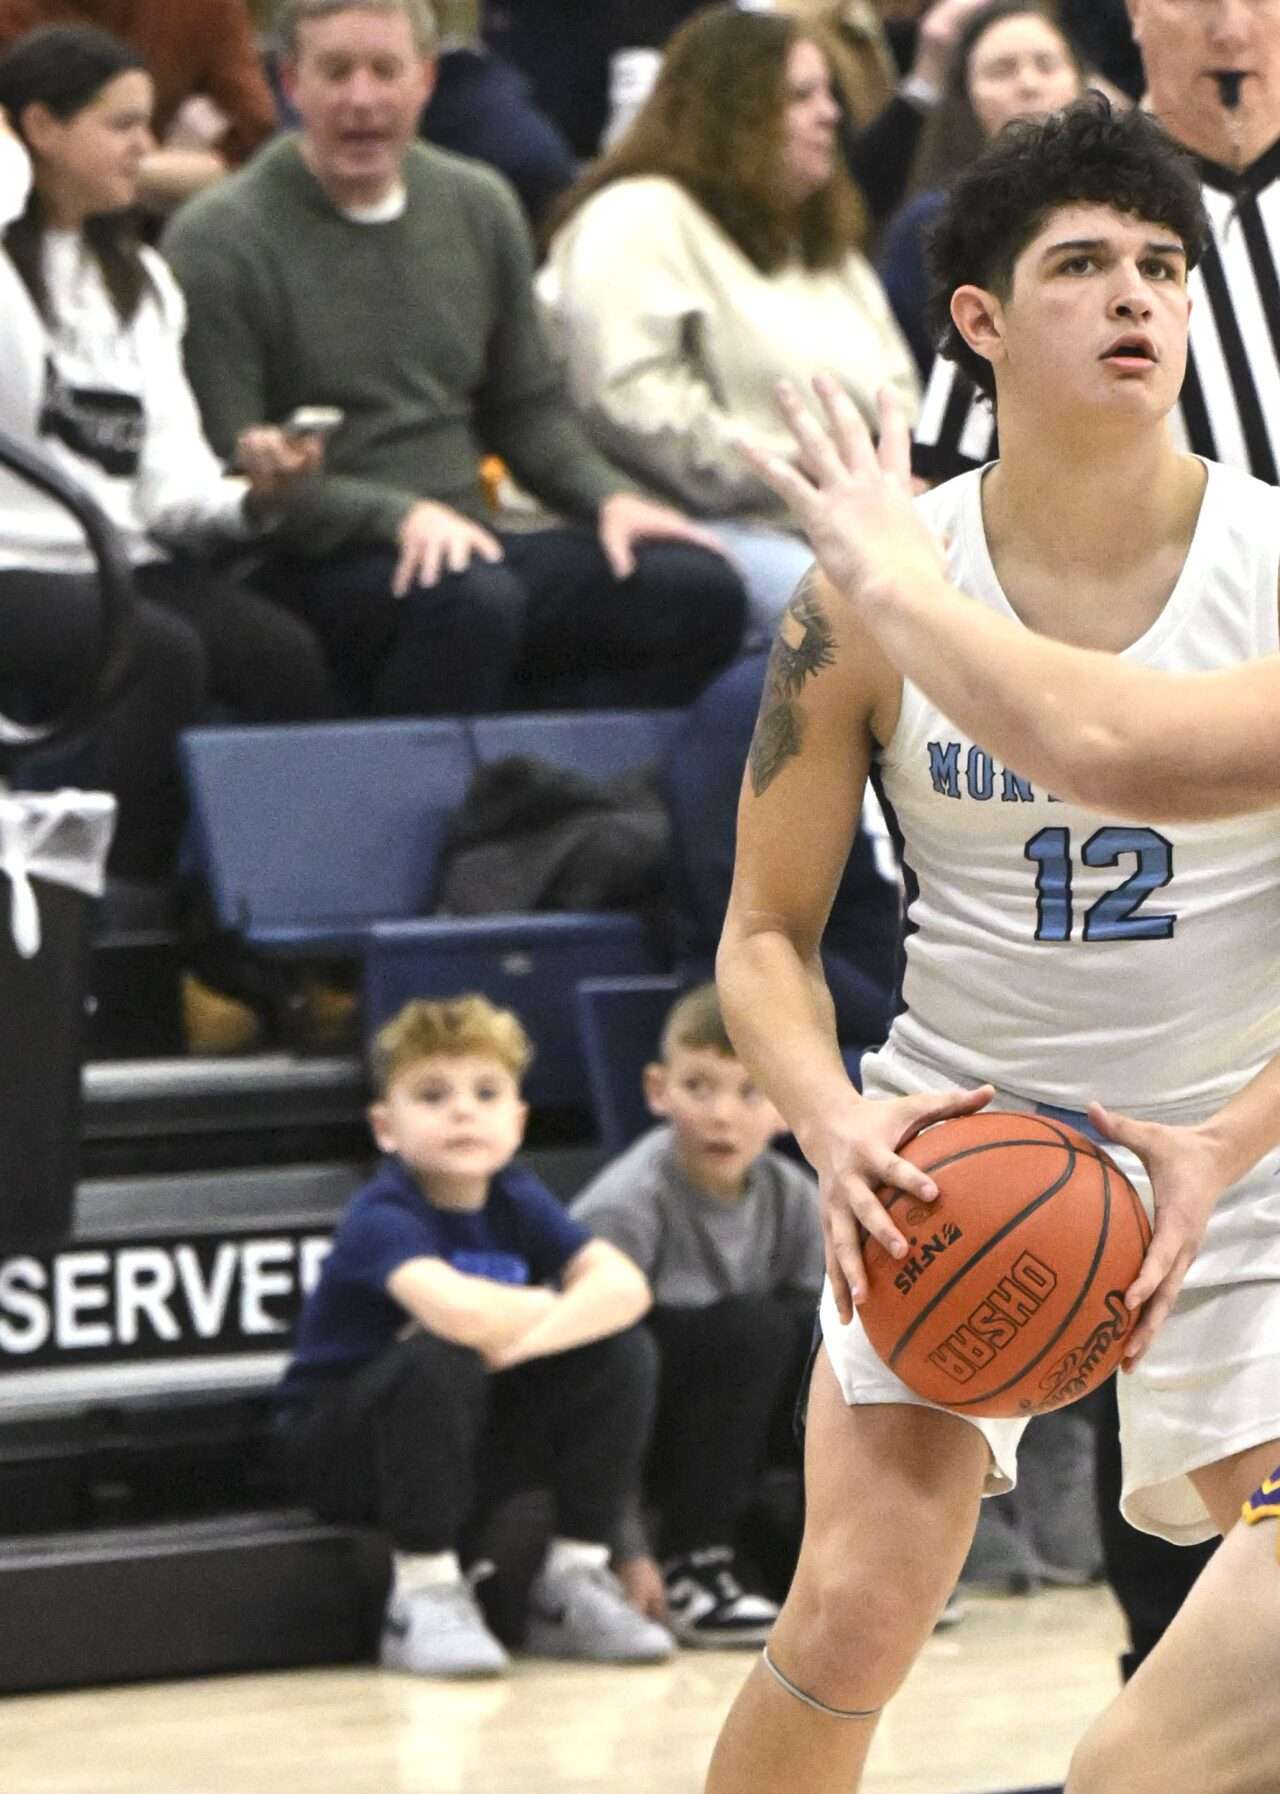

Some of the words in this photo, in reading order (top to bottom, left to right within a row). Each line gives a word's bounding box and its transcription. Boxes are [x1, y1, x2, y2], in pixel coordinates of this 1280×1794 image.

[927, 742, 1064, 802] MON
[1024, 826, 1177, 942] 12
[894, 1230, 949, 1295] NFHS
[928, 1250, 1057, 1384] OHSAA
